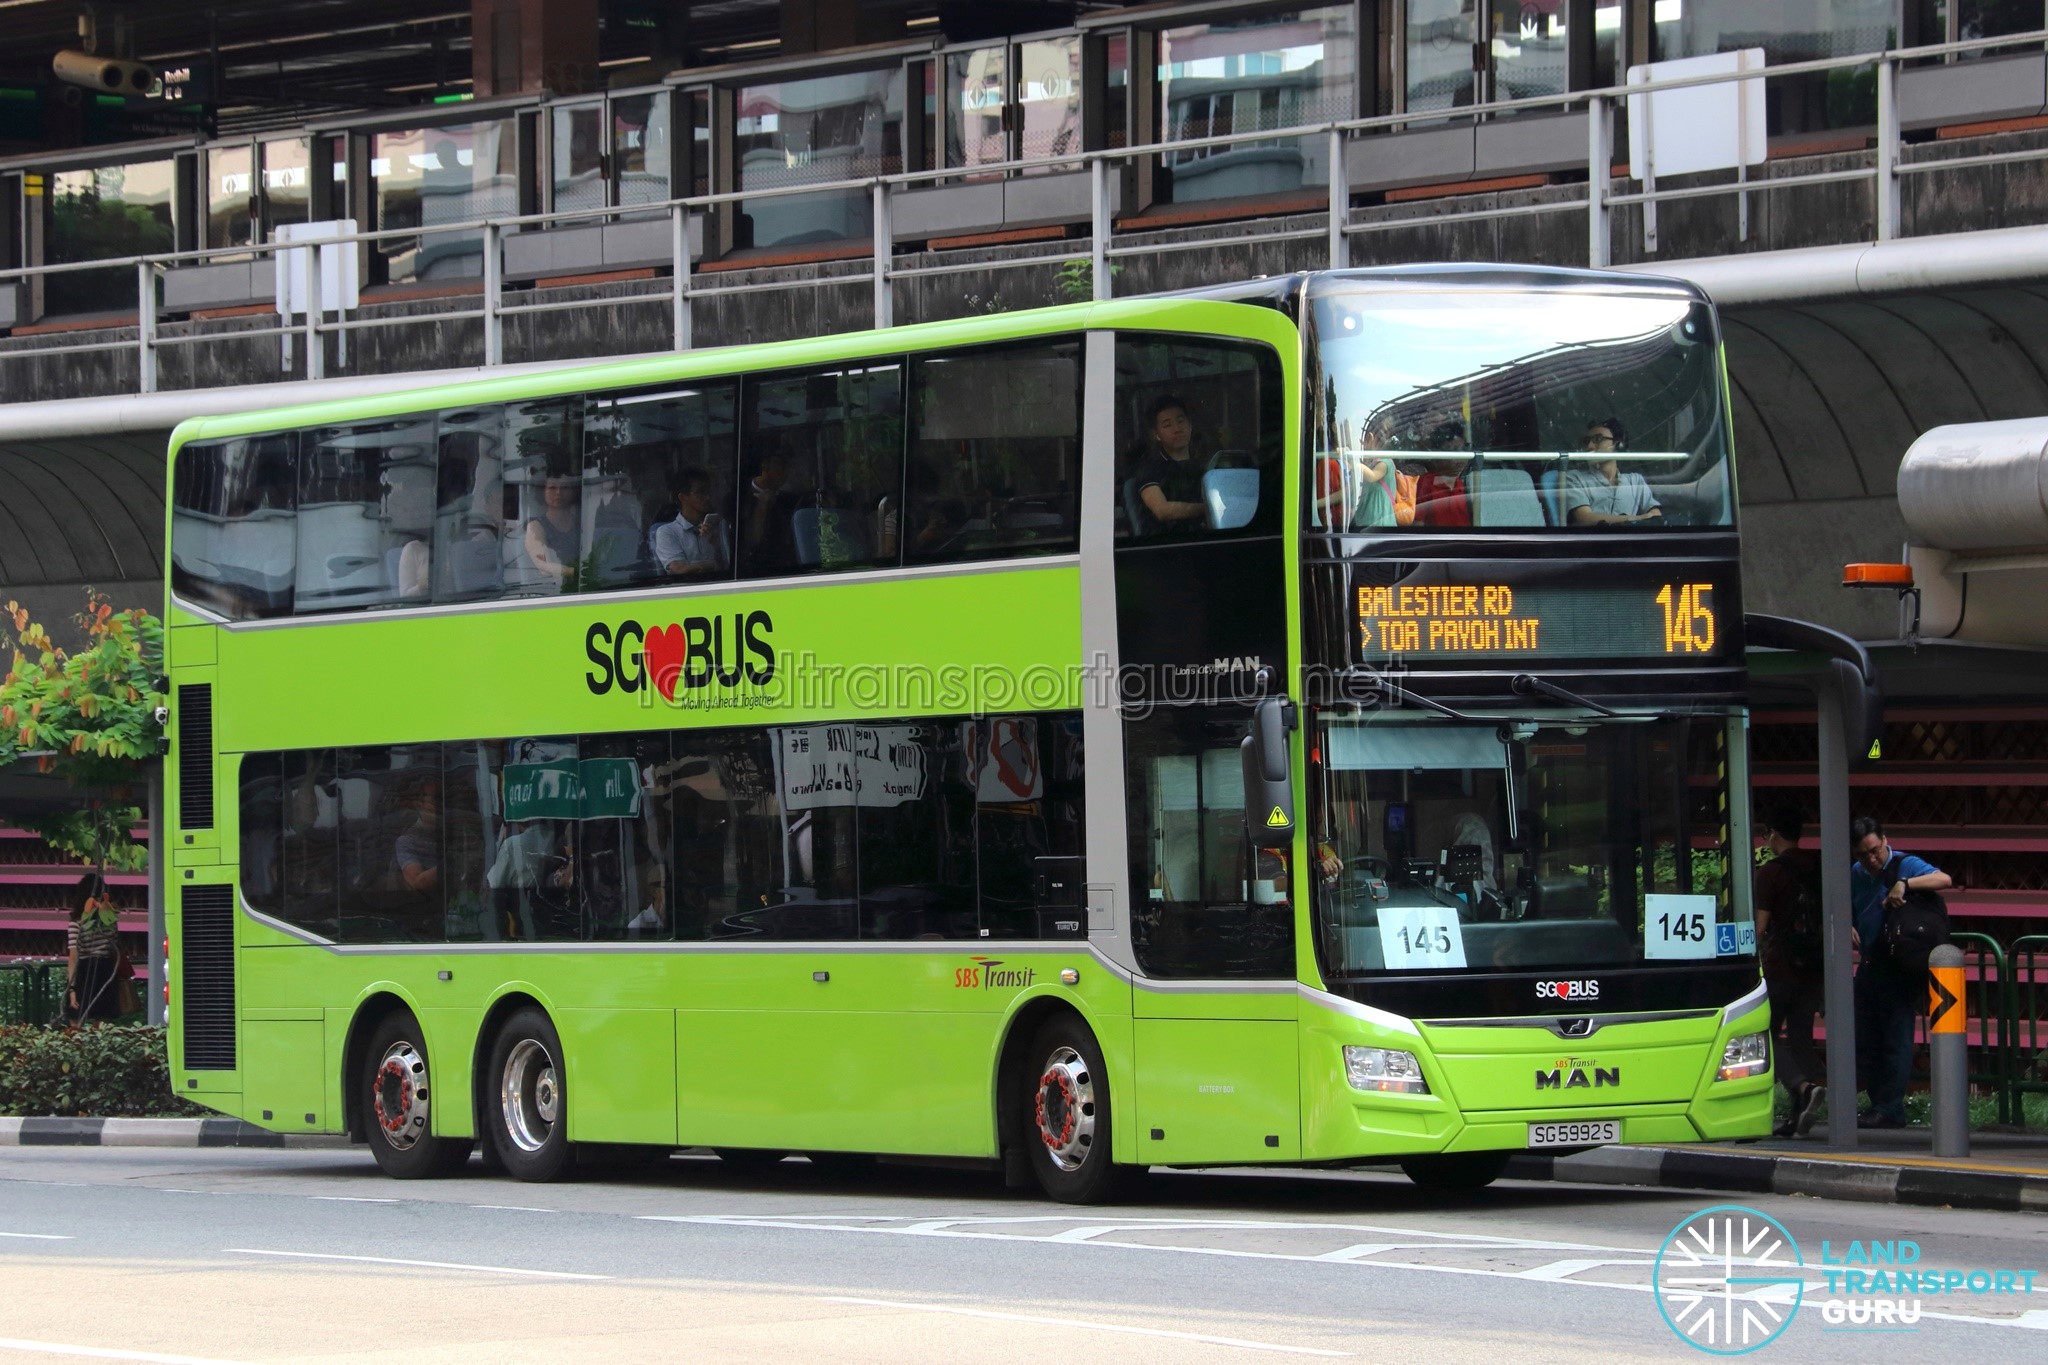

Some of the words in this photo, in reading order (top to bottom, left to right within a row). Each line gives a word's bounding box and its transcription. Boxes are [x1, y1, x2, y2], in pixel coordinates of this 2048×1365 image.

[1359, 586, 1478, 617] BALESTIER
[1484, 585, 1512, 616] RD
[1656, 584, 1715, 652] 145
[1378, 621, 1419, 650] TOA
[1429, 620, 1499, 650] PAYOH
[1504, 619, 1539, 649] INT
[586, 622, 647, 695] SG
[684, 610, 775, 688] BUS
[1214, 656, 1260, 673] MAN
[681, 697, 711, 712] Moving
[712, 694, 739, 708] Ahead
[741, 693, 775, 710] Together
[1396, 925, 1452, 954] 145
[1658, 912, 1706, 943] 145
[955, 968, 979, 988] SBS
[978, 961, 1038, 992] Transit
[1536, 981, 1557, 998] SG
[1570, 980, 1600, 997] BUS
[1555, 1060, 1568, 1069] SBS
[1568, 1057, 1597, 1068] Transit
[1199, 1085, 1222, 1093] BATTERY
[1535, 1067, 1620, 1090] MAN
[1535, 1123, 1613, 1143] SG5992S
